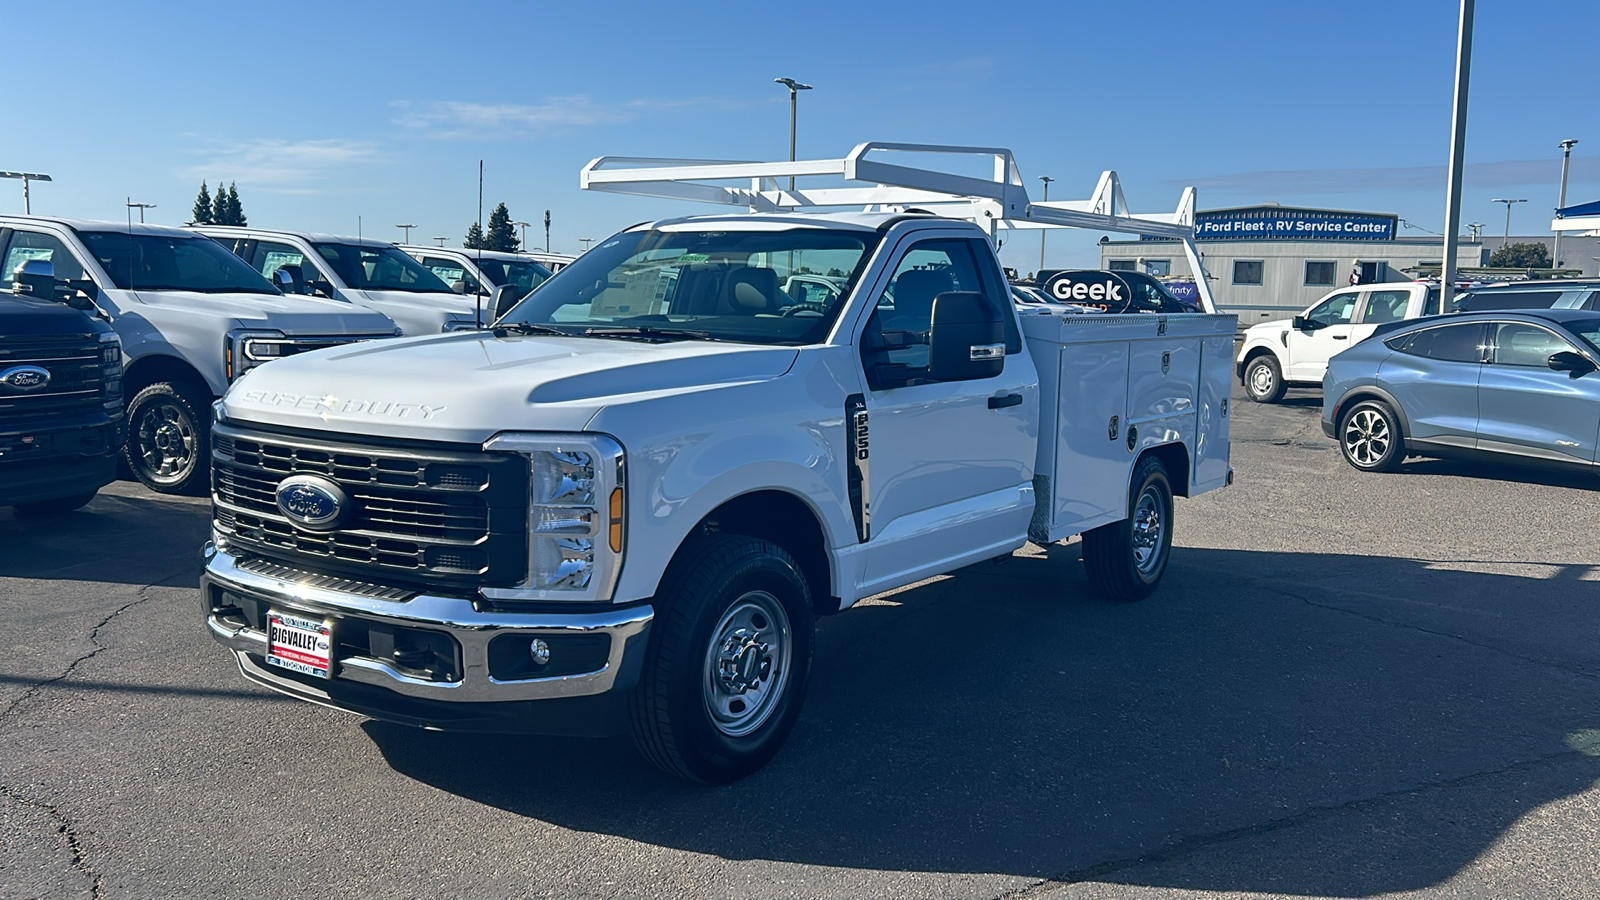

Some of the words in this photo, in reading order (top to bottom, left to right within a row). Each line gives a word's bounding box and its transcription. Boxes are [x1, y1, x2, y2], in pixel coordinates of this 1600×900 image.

[1205, 221, 1232, 232] Ford
[1234, 221, 1264, 232] Fleet
[1266, 222, 1274, 231] &
[1276, 220, 1295, 231] RV
[1296, 221, 1342, 232] Service
[1344, 222, 1387, 233] Center
[1053, 278, 1122, 301] Geek
[1168, 285, 1192, 296] finity
[14, 372, 40, 385] Ford
[243, 390, 337, 412] SUPER
[342, 399, 448, 420] DUTY
[288, 488, 324, 515] Ford
[272, 627, 318, 651] BIGVALLEY
